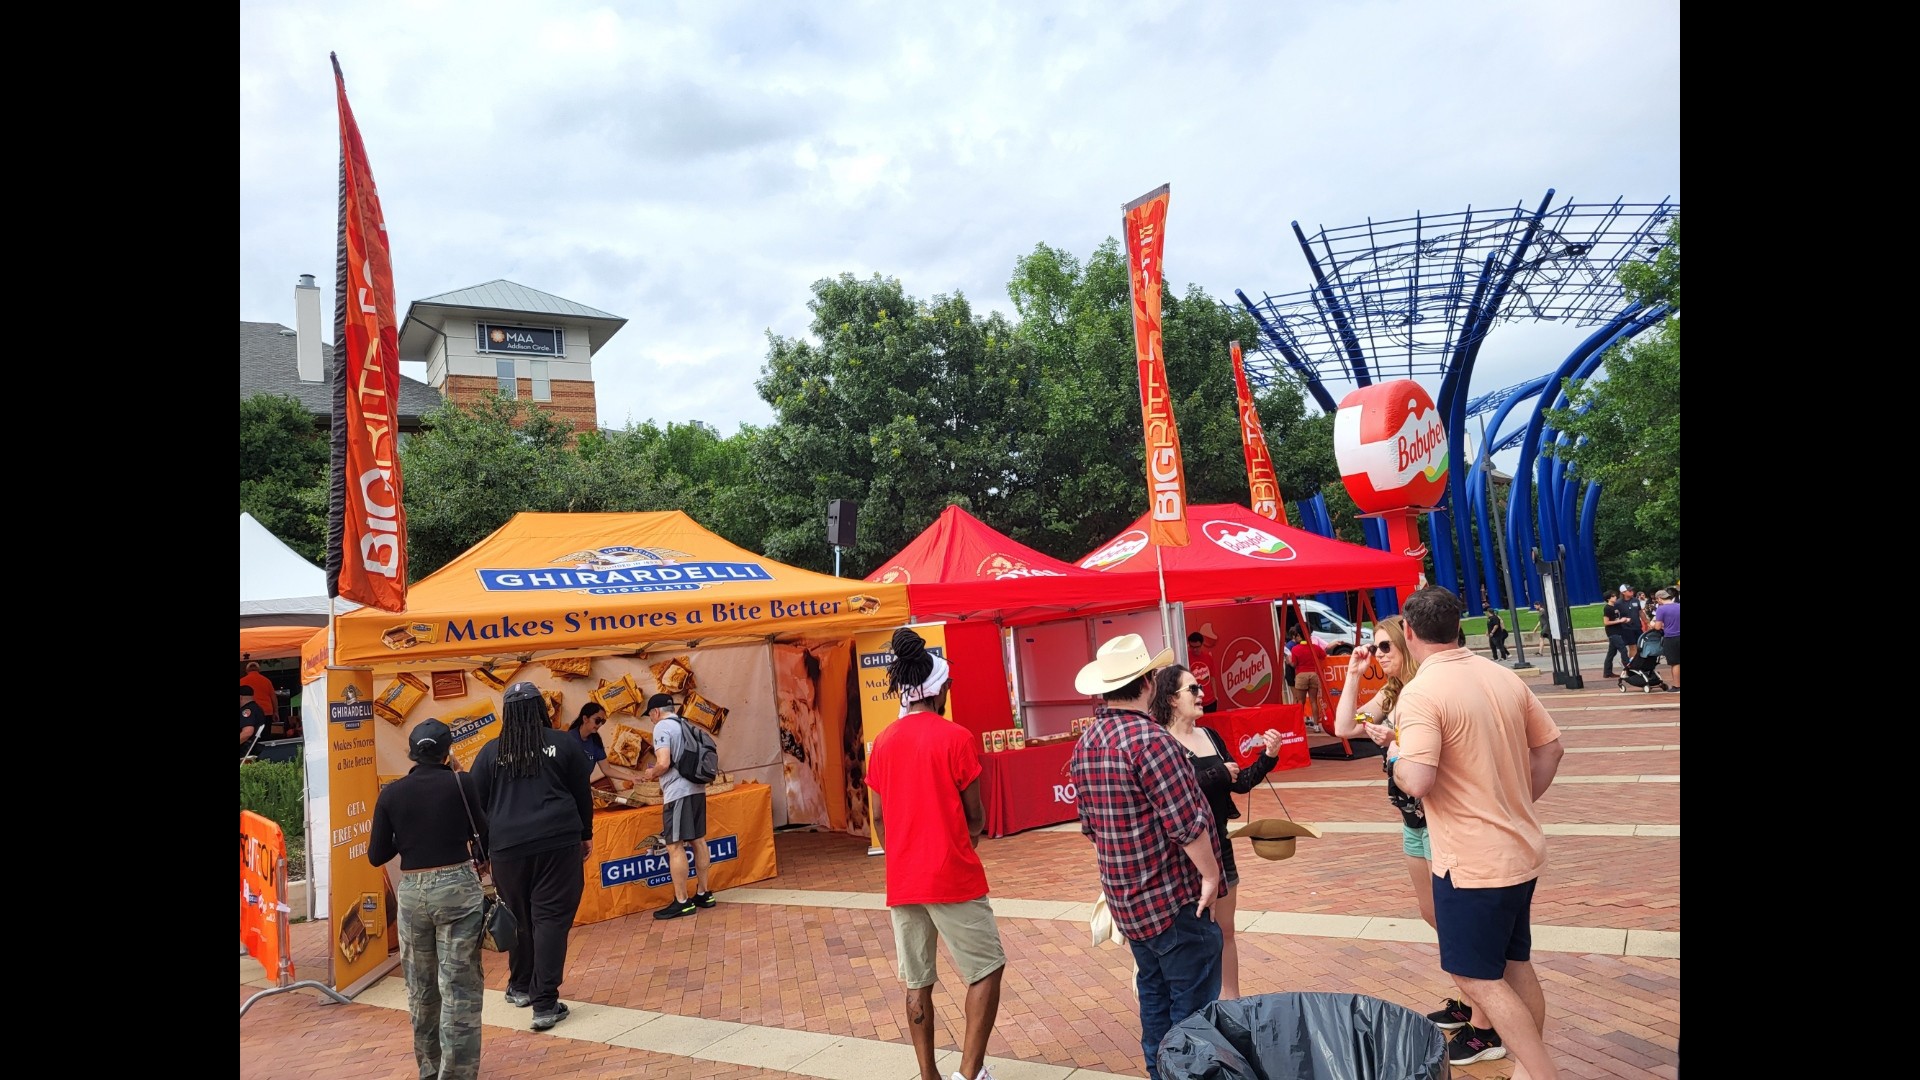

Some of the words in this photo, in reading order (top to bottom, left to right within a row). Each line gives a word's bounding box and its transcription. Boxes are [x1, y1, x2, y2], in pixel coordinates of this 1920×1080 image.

[506, 332, 534, 343] MAA
[507, 342, 532, 350] Addison
[1397, 418, 1445, 473] Babybel
[1223, 531, 1269, 552] Babybel
[495, 565, 760, 587] GHIRARDELLI
[595, 584, 694, 594] CHOCOLATE
[445, 615, 554, 642] Makes
[565, 610, 677, 632] S'mores
[686, 609, 703, 624] a
[711, 602, 761, 622] Bite
[770, 599, 842, 618] Better
[1226, 655, 1265, 691] Babybel
[331, 704, 373, 719] GHIRARDELLI
[333, 739, 352, 752] Makes
[337, 762, 342, 770] a
[343, 758, 354, 769] Bite
[354, 756, 373, 768] Better
[347, 801, 360, 817] GET
[361, 800, 366, 813] A
[333, 825, 352, 845] FREE
[353, 819, 372, 837] S'MO
[349, 840, 368, 860] HERE
